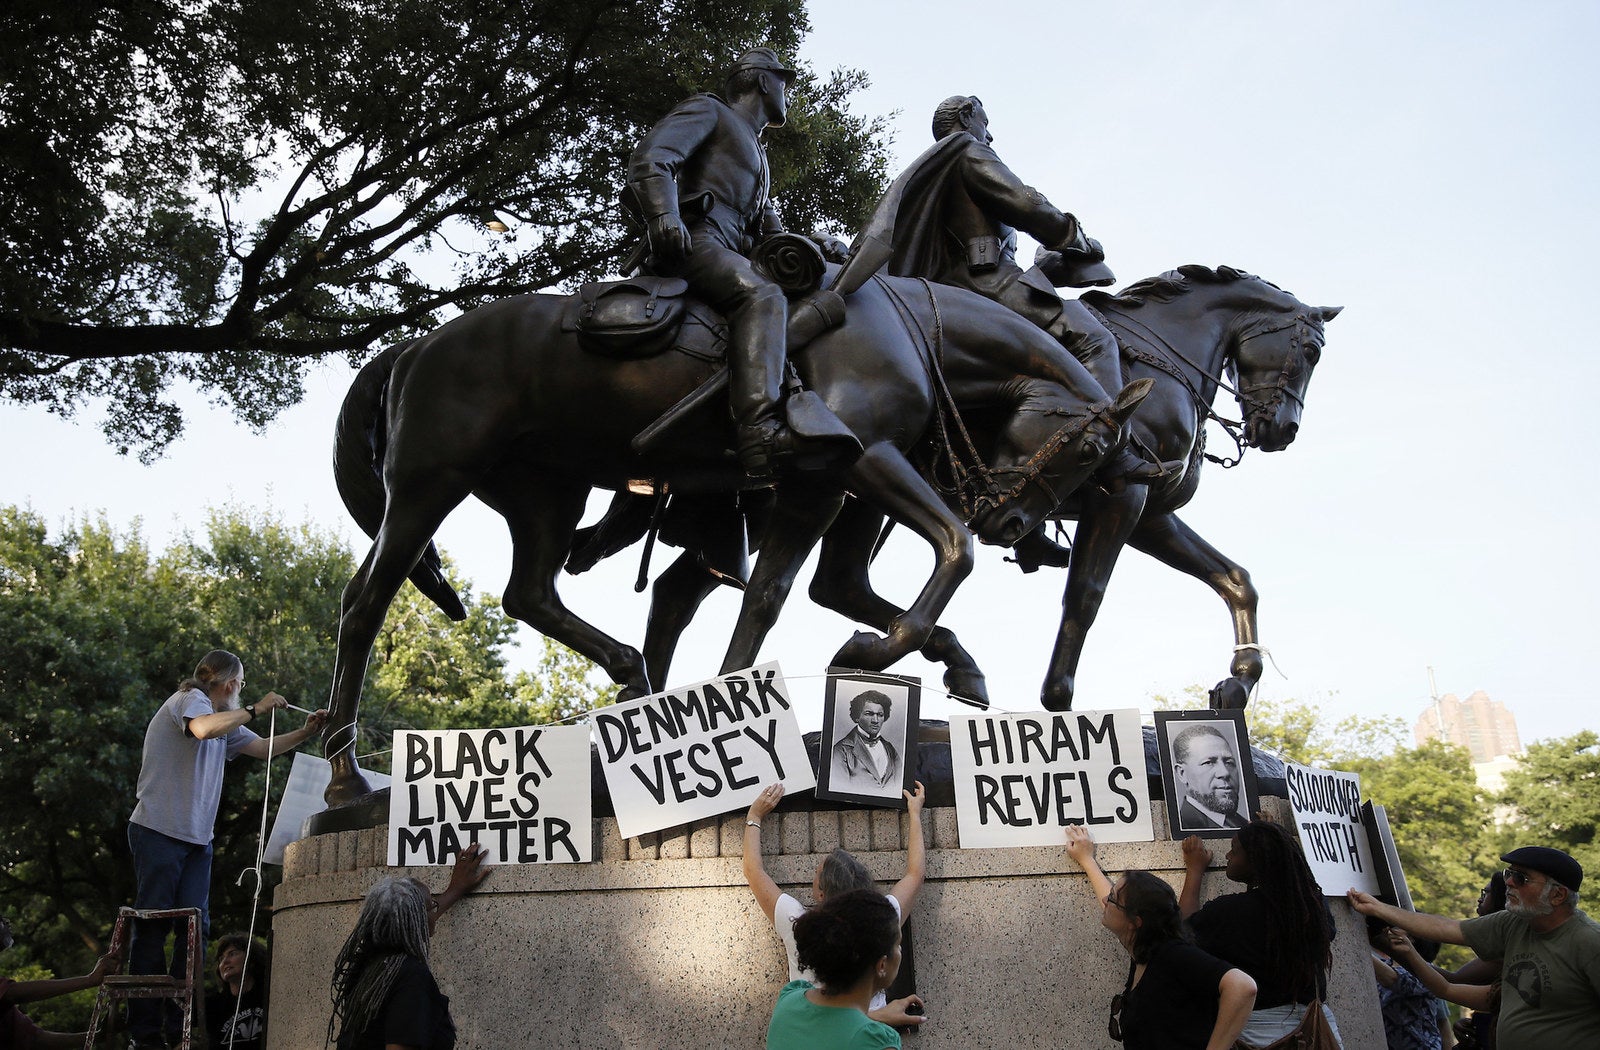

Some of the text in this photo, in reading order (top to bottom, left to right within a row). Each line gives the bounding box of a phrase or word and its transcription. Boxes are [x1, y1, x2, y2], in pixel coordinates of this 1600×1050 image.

[596, 670, 790, 763] DENMARK
[968, 714, 1121, 766] HIRAM
[406, 730, 552, 782] BLACK
[630, 719, 785, 805] VESEY
[409, 772, 541, 826] LIVES
[975, 766, 1138, 826] REVELS
[1287, 765, 1364, 826] SOJOURNER
[399, 817, 580, 864] MATTER
[1302, 822, 1363, 874] TRUTH
